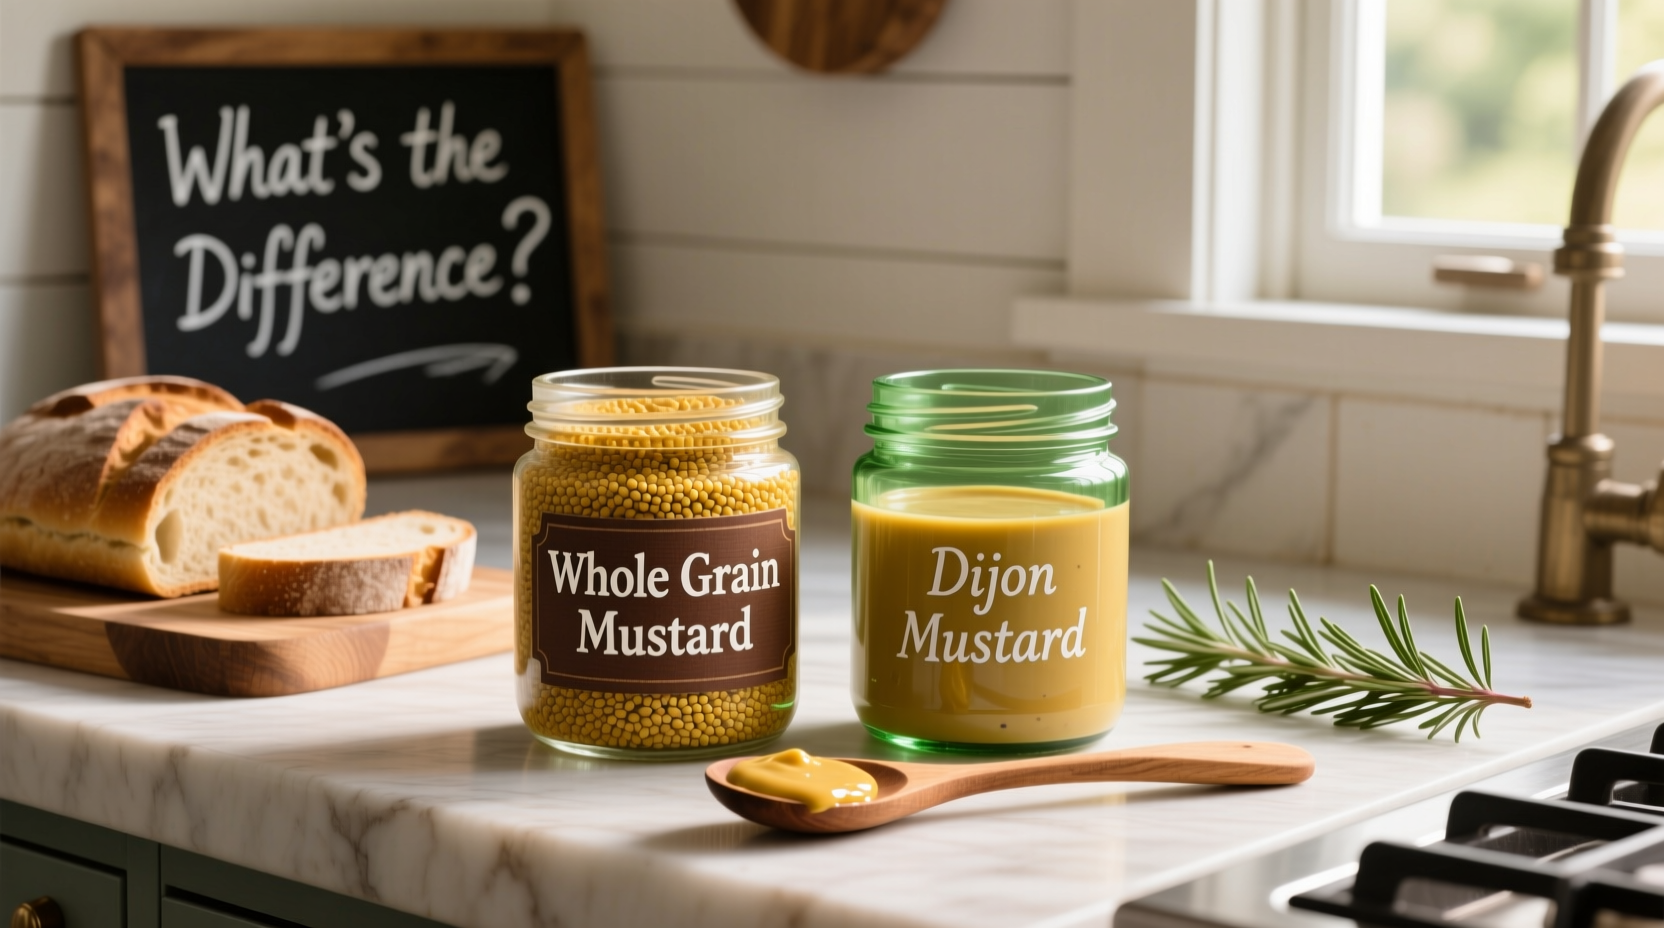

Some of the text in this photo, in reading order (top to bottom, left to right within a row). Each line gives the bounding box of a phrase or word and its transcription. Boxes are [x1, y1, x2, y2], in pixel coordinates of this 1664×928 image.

[158, 101, 508, 206] What's the
[173, 196, 551, 358] Difference?
[548, 548, 781, 598] Whole Grain
[927, 546, 1057, 615] Dijon
[576, 604, 754, 656] Mustard
[896, 606, 1087, 664] Mustard
